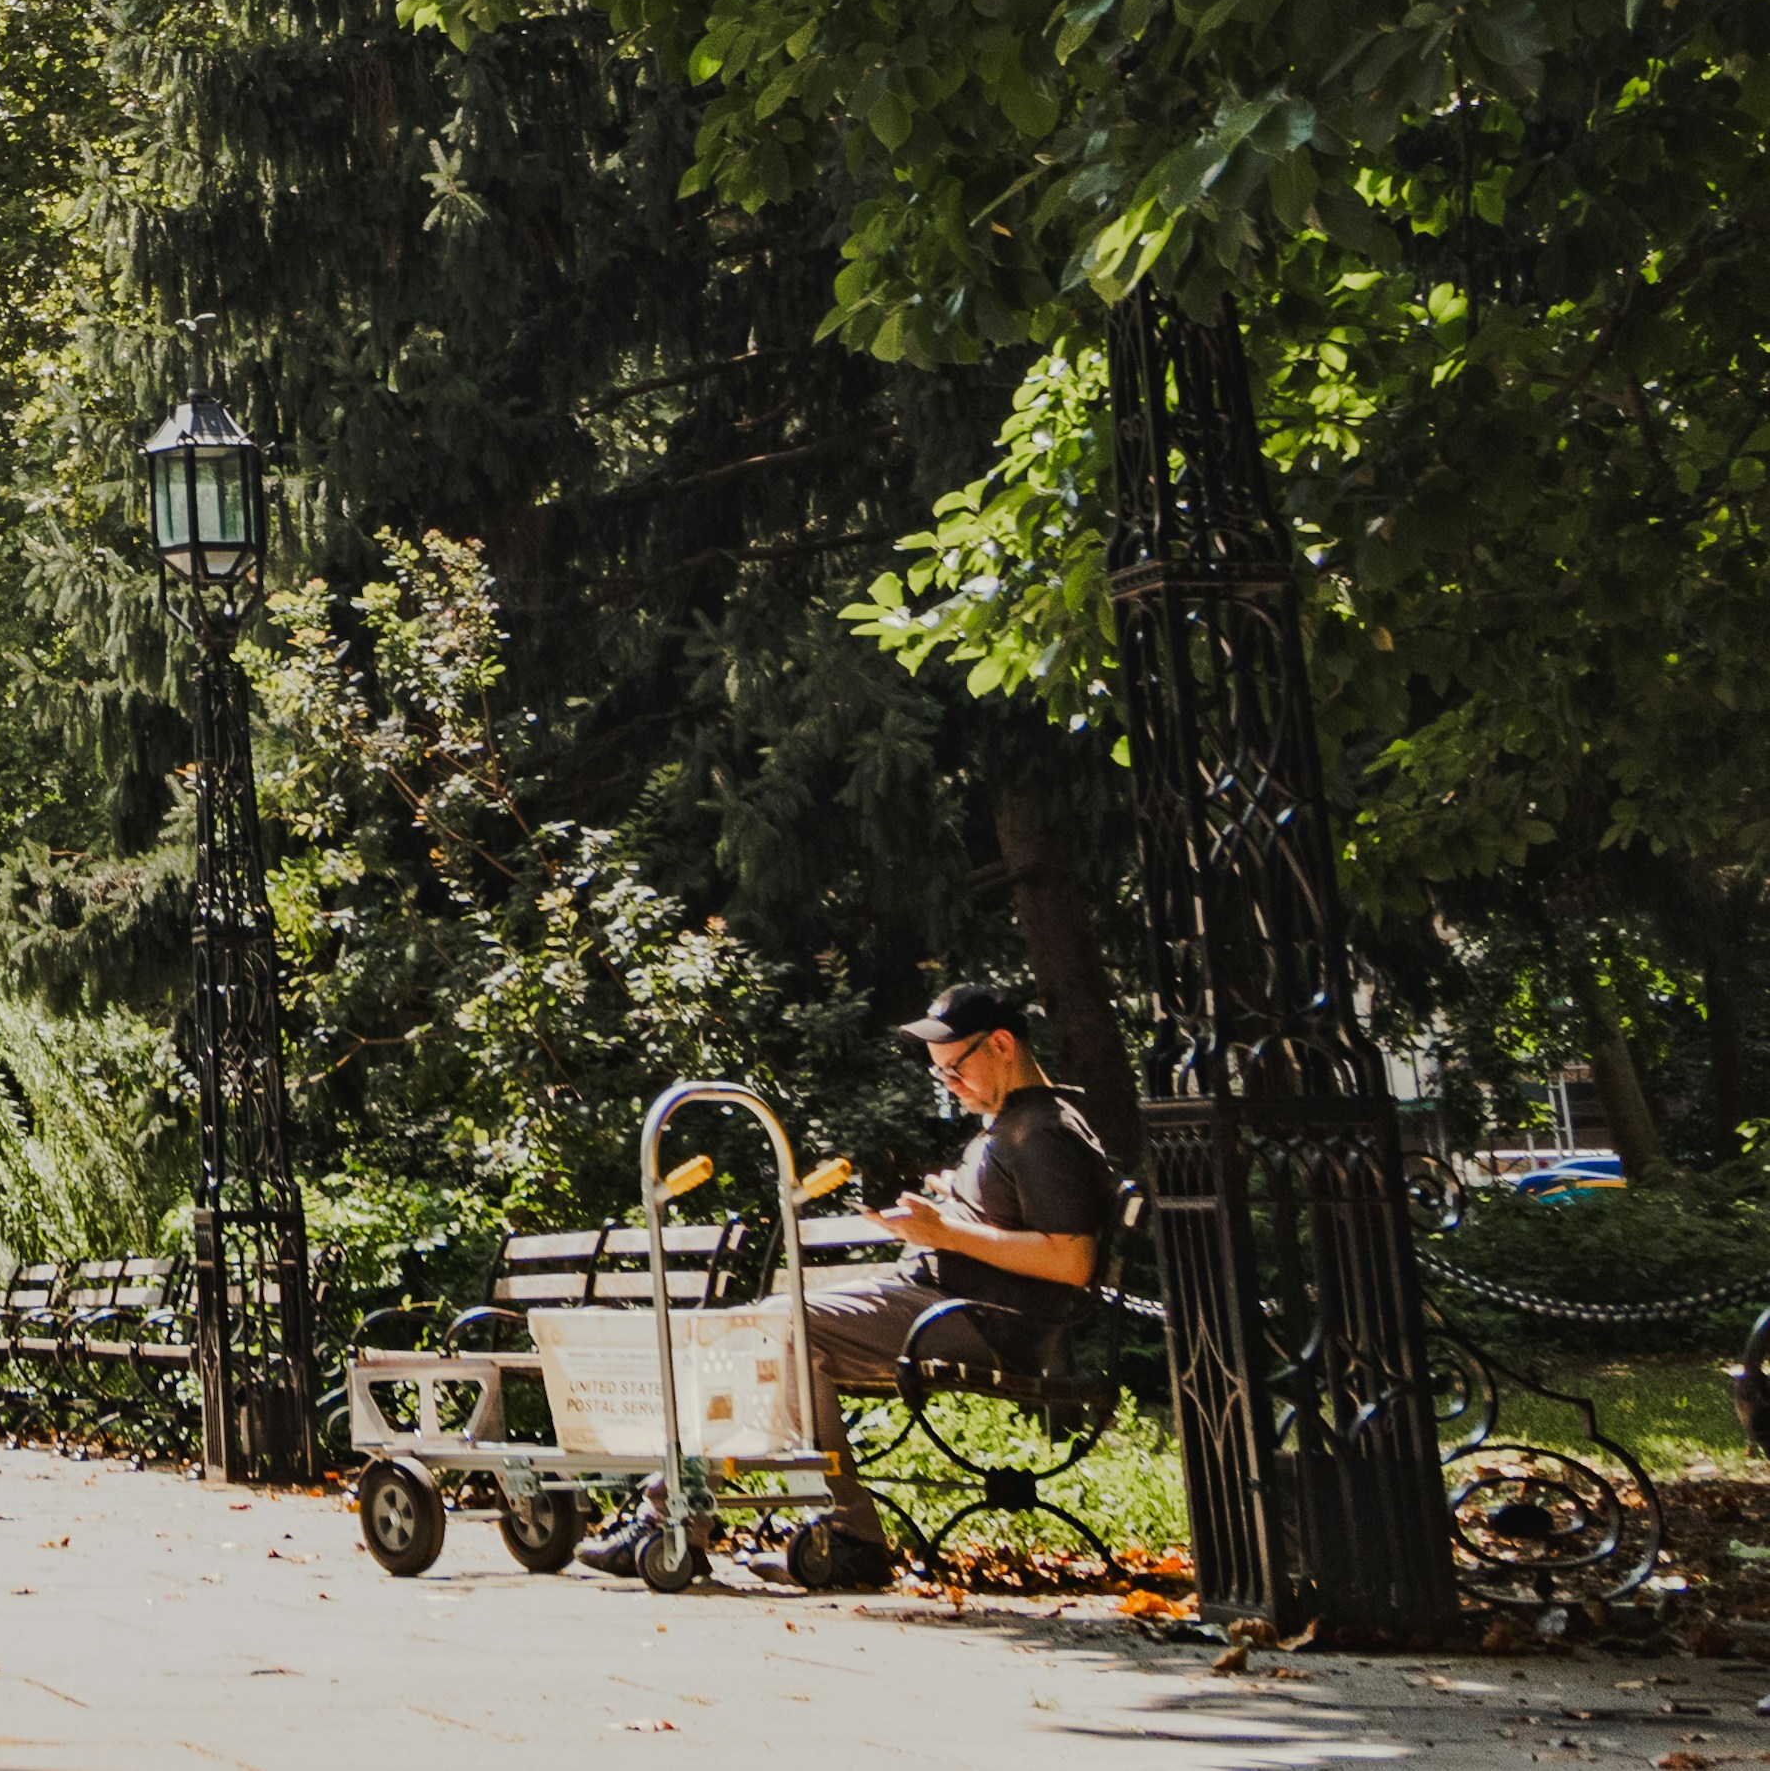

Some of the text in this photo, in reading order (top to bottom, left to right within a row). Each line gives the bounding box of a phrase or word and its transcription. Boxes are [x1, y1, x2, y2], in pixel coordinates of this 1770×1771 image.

[569, 1380, 663, 1396] UNITED STATE
[566, 1398, 617, 1413] POSTAL
